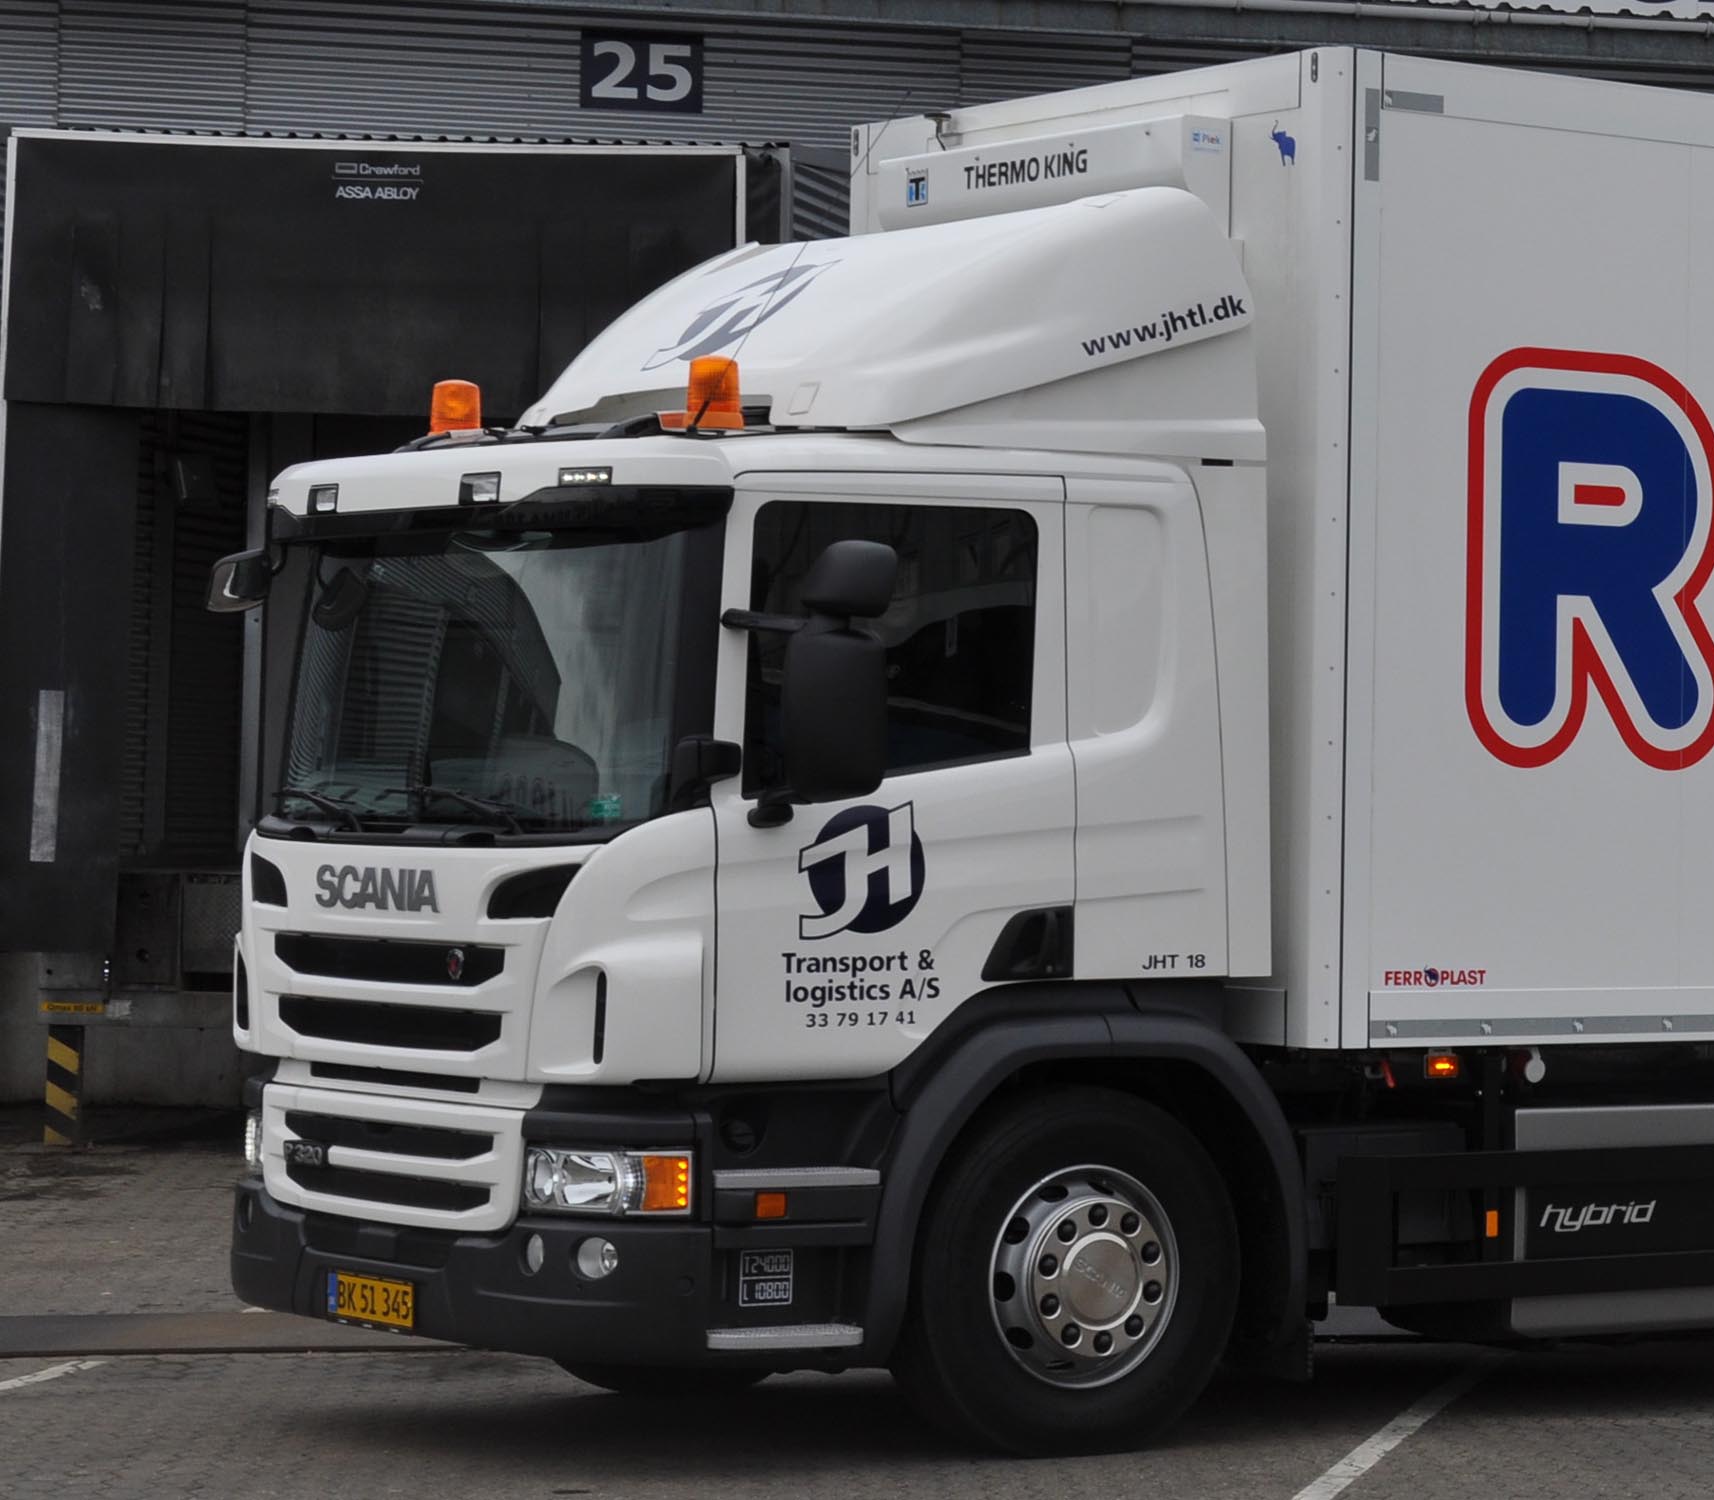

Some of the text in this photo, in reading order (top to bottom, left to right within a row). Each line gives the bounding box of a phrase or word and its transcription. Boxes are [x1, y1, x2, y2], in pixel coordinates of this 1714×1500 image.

[591, 40, 692, 101] 25
[359, 163, 420, 175] Crawford
[963, 149, 1088, 190] THERMO KING
[335, 185, 420, 200] ASSA ABLOY
[1081, 295, 1247, 356] www.jhtl.dk
[315, 864, 441, 913] SCANIA
[782, 949, 935, 977] Transport &
[1142, 954, 1206, 970] JHT 18
[1384, 966, 1486, 987] FERROPLAST
[785, 977, 940, 1007] logistics A/S
[806, 1010, 916, 1028] 33 79 17 41
[1540, 1200, 1656, 1232] hybrid
[338, 1280, 410, 1320] BK 51 345
